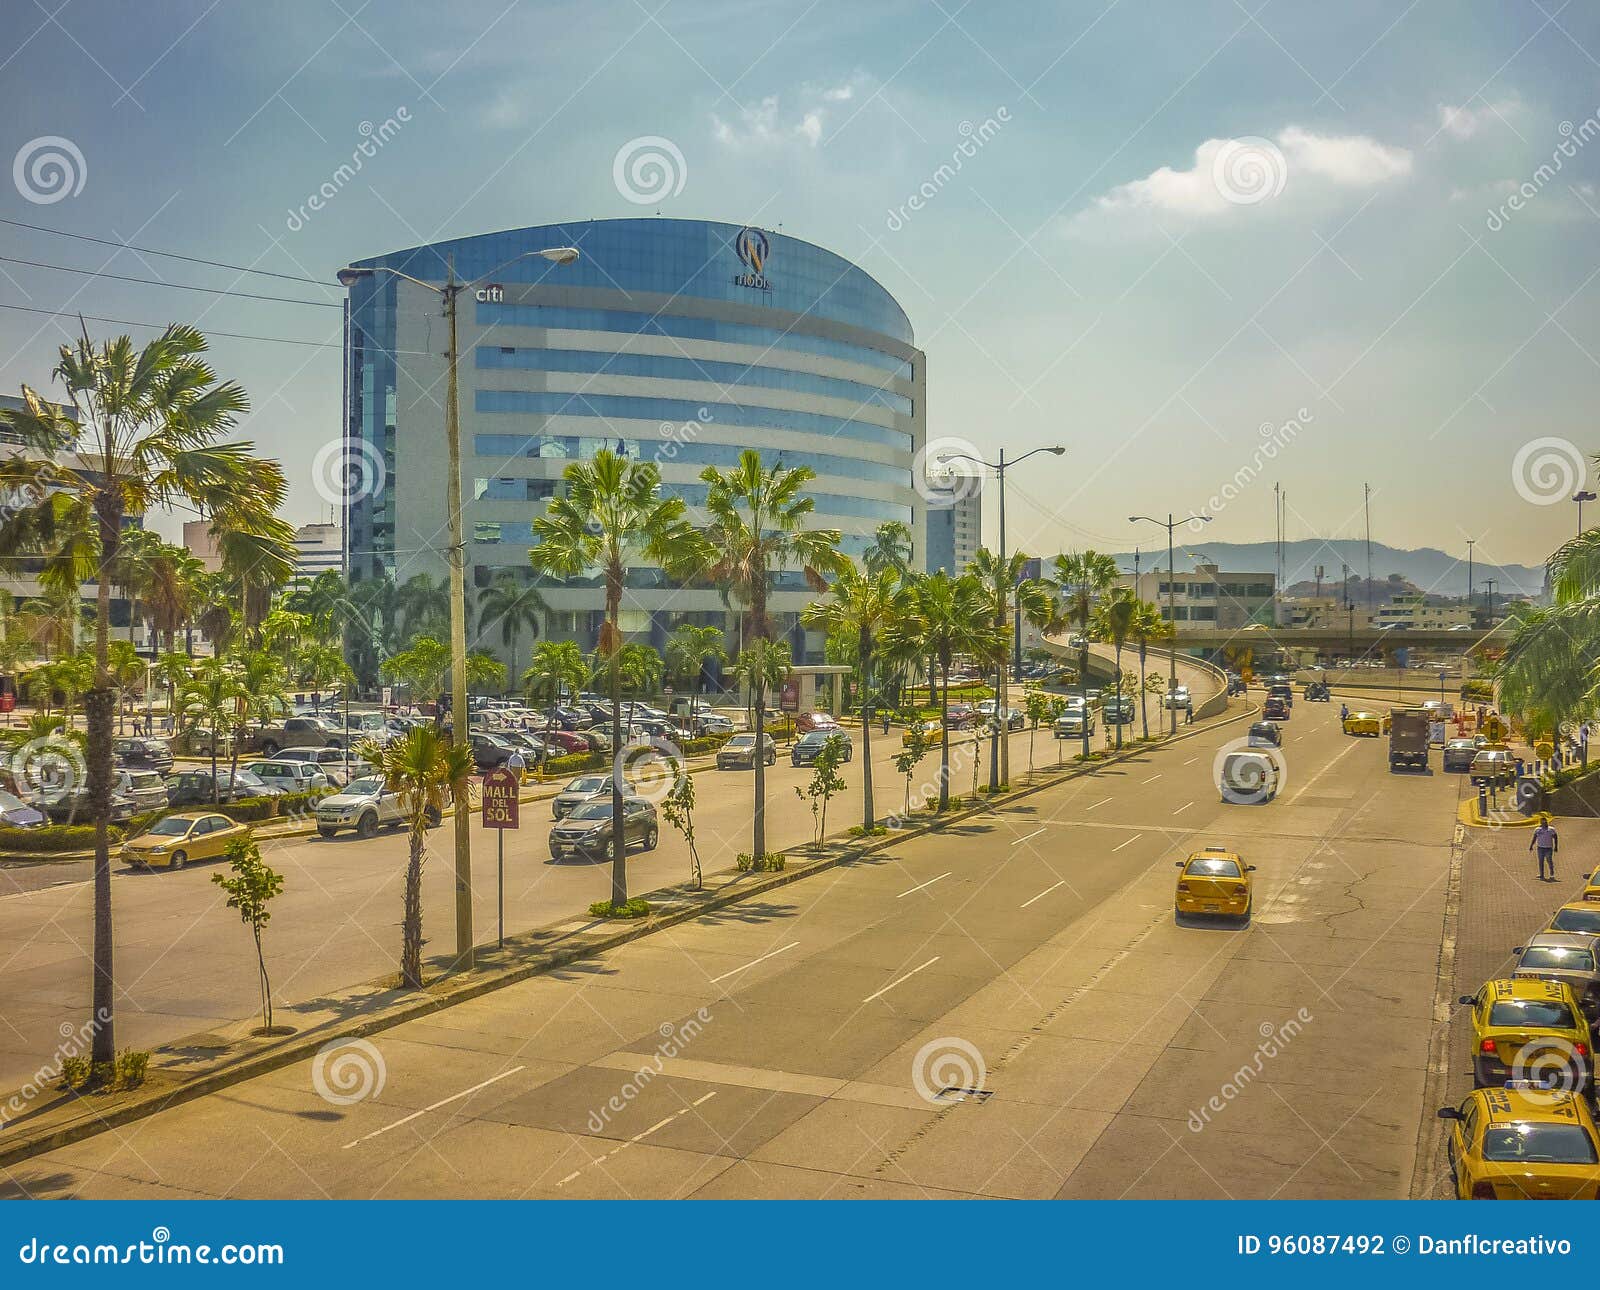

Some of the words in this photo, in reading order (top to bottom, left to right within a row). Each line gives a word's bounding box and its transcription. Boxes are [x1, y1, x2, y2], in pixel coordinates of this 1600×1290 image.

[475, 286, 503, 302] citi
[484, 786, 516, 798] MALL
[492, 799, 508, 808] DEL
[487, 808, 512, 822] SOL
